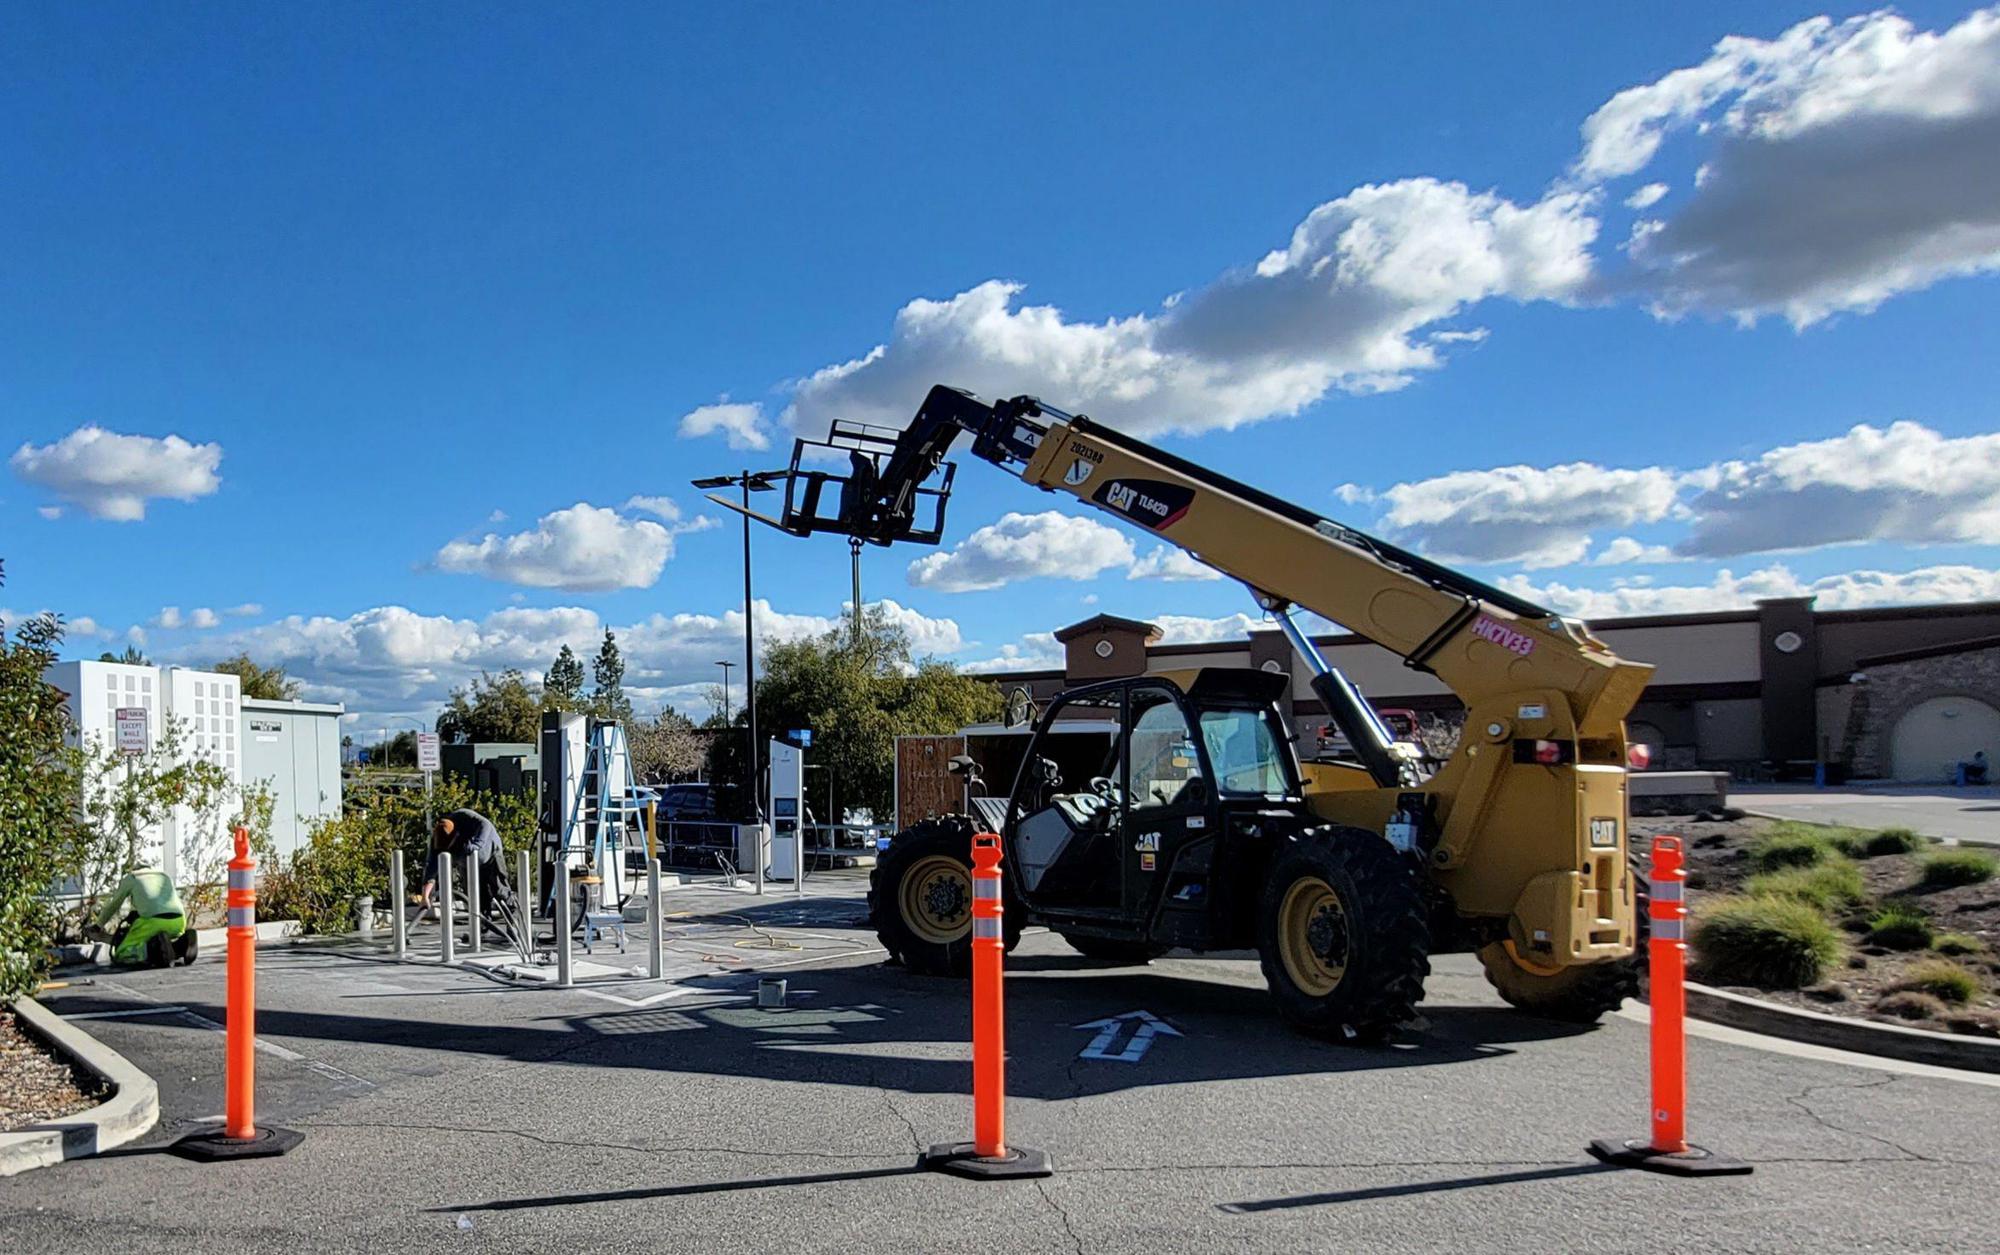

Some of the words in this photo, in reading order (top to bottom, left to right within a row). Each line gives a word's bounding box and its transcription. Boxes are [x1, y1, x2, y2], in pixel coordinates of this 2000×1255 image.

[1107, 482, 1138, 512] CAT
[1135, 831, 1161, 852] CAT
[1591, 820, 1615, 845] CAT
